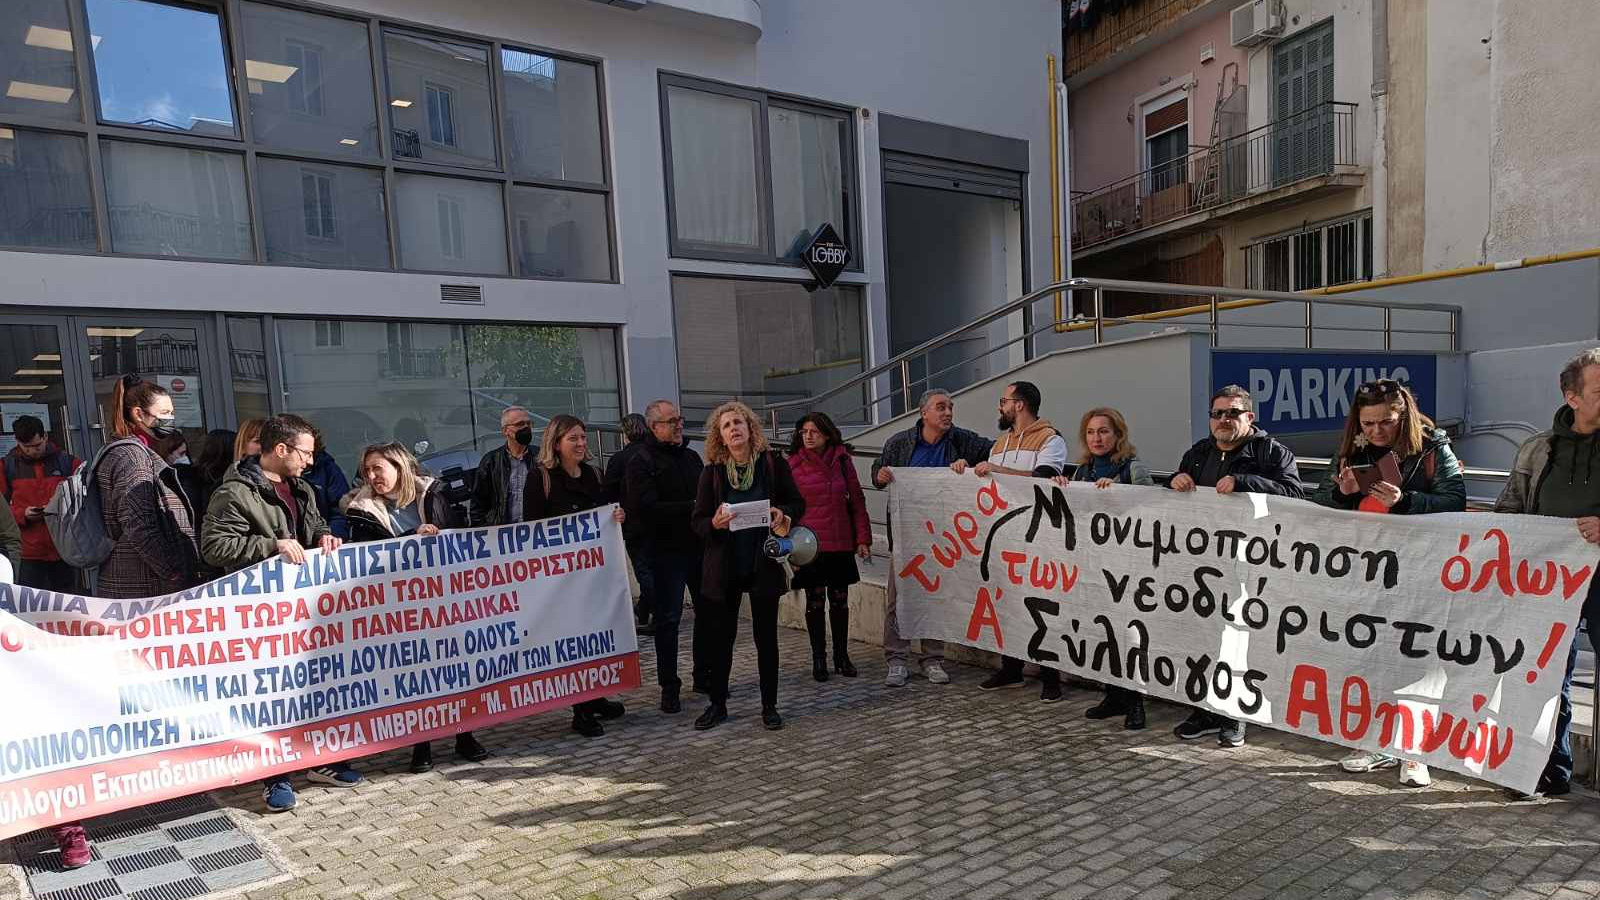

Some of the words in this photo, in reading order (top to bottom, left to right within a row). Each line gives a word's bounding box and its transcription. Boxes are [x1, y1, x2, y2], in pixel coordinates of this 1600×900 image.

[812, 246, 847, 265] LOBBY
[1249, 366, 1410, 422] PARK
[235, 596, 311, 630] ΤΩΡΑ
[317, 582, 385, 617] ΟΛΩΝ
[392, 576, 443, 602] ΤΩΝ
[450, 546, 605, 595] ΝΕΟΔΙΟΡΙΣΤΩΝ
[295, 529, 491, 589] ΔΙΑΠΙΣΤΩΤΙΚΗΣ
[498, 511, 602, 555] ΠΡΑΞΗΣ!
[1001, 550, 1079, 592] των
[1441, 528, 1592, 600] όλων
[352, 590, 520, 640] ΠΑΝΕΛΛΑΔΙΚΑ!
[215, 673, 248, 700] ΚΑΙ
[255, 651, 345, 695] ΣΤΑΘΕΡΗ
[350, 638, 431, 677] ΔΟΥΛΕΙΑ
[435, 637, 459, 660] ΓΙΑ
[464, 621, 520, 655] ΟΛΟΥΣ
[229, 681, 378, 735] ΑΝΑΠΛΗΡΩΤΩΝ
[394, 663, 470, 699] ΚΑΛΥΨΗ
[475, 650, 519, 683] ΟΛΩΝ
[522, 644, 551, 668] ΤΩΝ
[554, 629, 616, 663] ΚΕΝΩΝ!
[1024, 597, 1267, 714] Σύλλογος
[1286, 664, 1513, 769] Αθηνών
[91, 745, 257, 803] Εκπαιδευτικών
[260, 736, 301, 767] Π.Ε.
[304, 721, 368, 757] "ΡΟΖΑ
[370, 698, 467, 742] ΙΜΒΡΙΩΤΗ"
[510, 660, 625, 706] ΠΑΠΑΜΑΥΡΟΣ"
